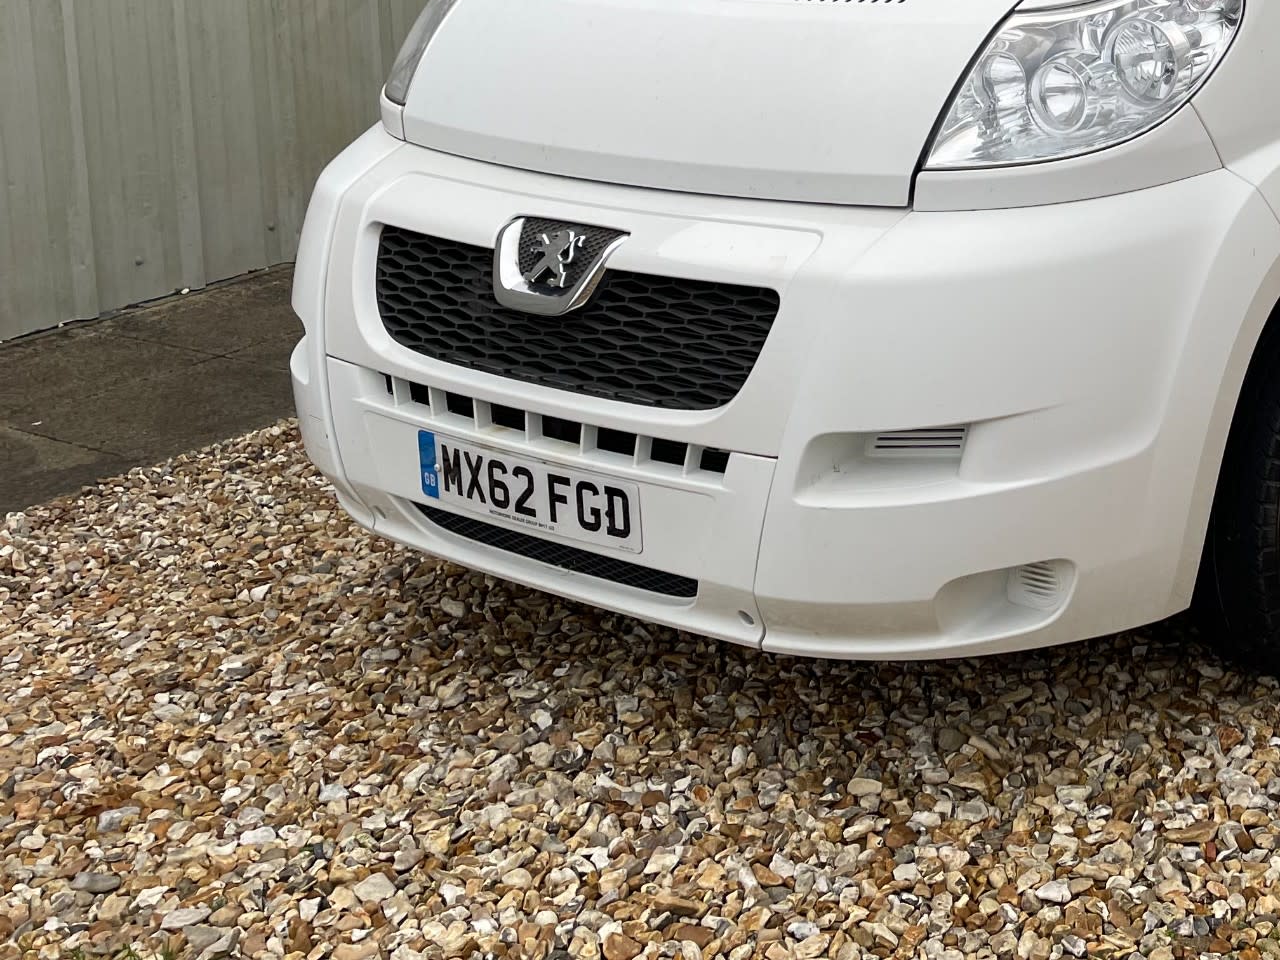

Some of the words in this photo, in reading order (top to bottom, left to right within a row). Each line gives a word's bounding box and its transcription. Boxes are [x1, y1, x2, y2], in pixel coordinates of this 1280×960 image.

[424, 472, 436, 487] GB
[441, 444, 537, 518] MX62
[547, 473, 631, 539] FGD
